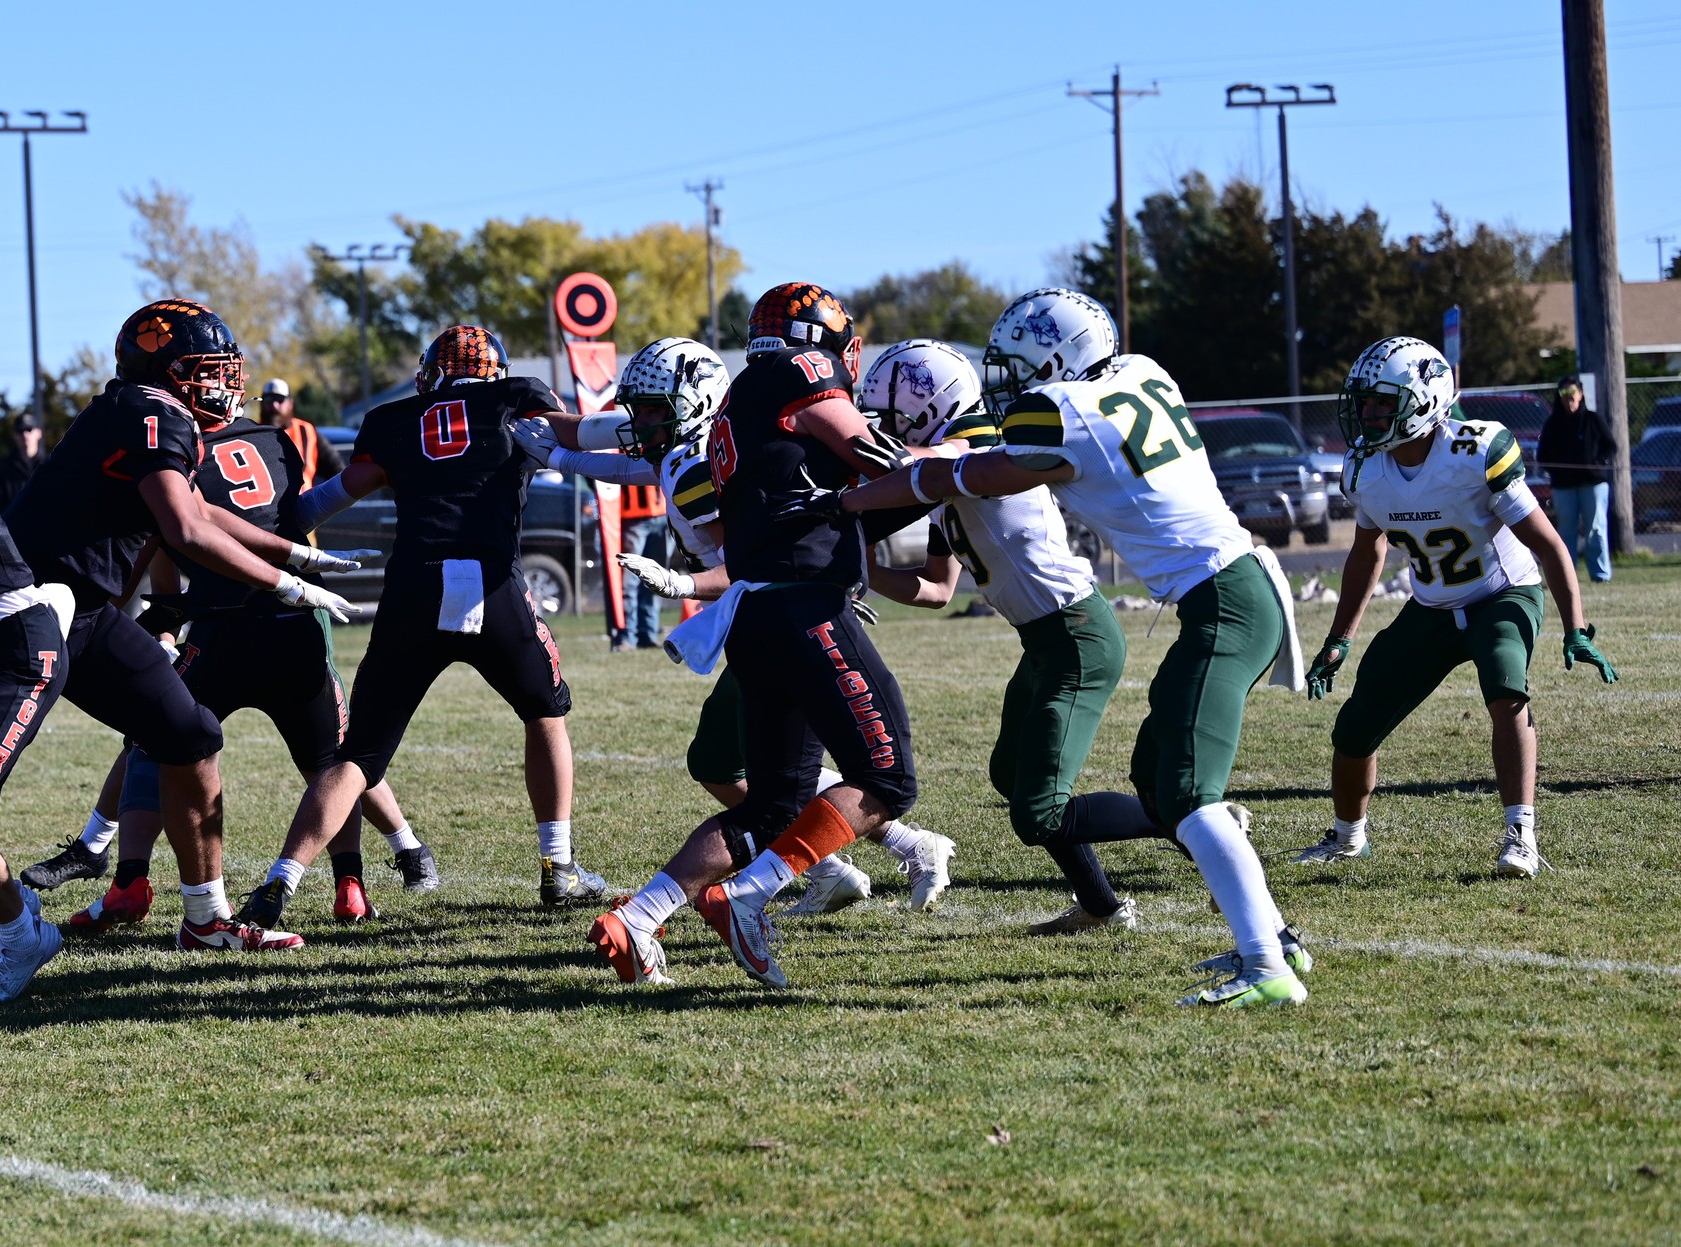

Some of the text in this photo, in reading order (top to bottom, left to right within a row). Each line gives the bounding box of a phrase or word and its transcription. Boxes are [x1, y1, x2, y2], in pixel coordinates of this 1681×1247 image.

[791, 351, 835, 384] 15
[144, 416, 158, 449] 1
[420, 400, 471, 461] 0
[1098, 378, 1203, 479] 26
[1451, 425, 1488, 457] 32
[212, 439, 276, 510] 9
[1388, 511, 1442, 522] ARICKAREE
[1386, 526, 1484, 588] 32
[806, 621, 895, 769] TIGERS
